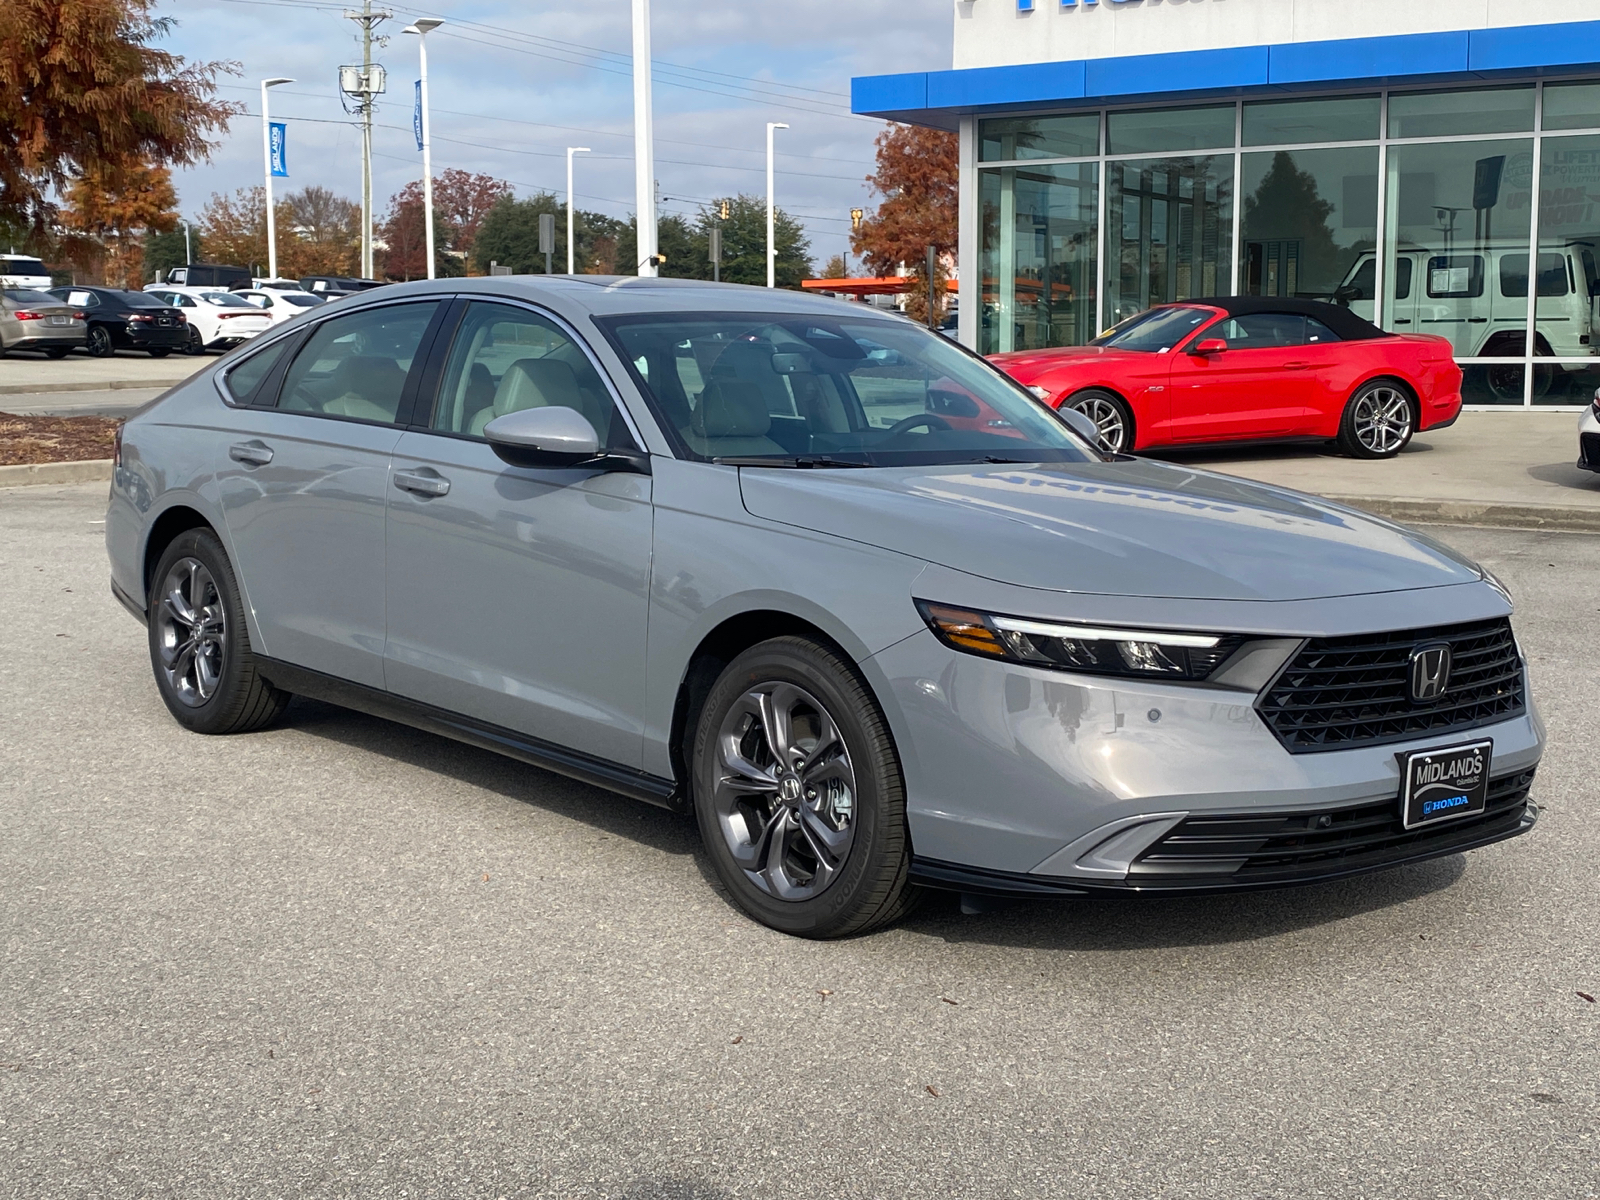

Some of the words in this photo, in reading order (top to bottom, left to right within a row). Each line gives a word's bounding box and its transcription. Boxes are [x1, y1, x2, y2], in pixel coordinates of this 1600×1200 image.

[271, 126, 280, 172] MIDLANDS
[1505, 185, 1587, 210] UPRADE
[1416, 755, 1483, 785] MIDLANDS
[1432, 795, 1469, 811] HONDA
